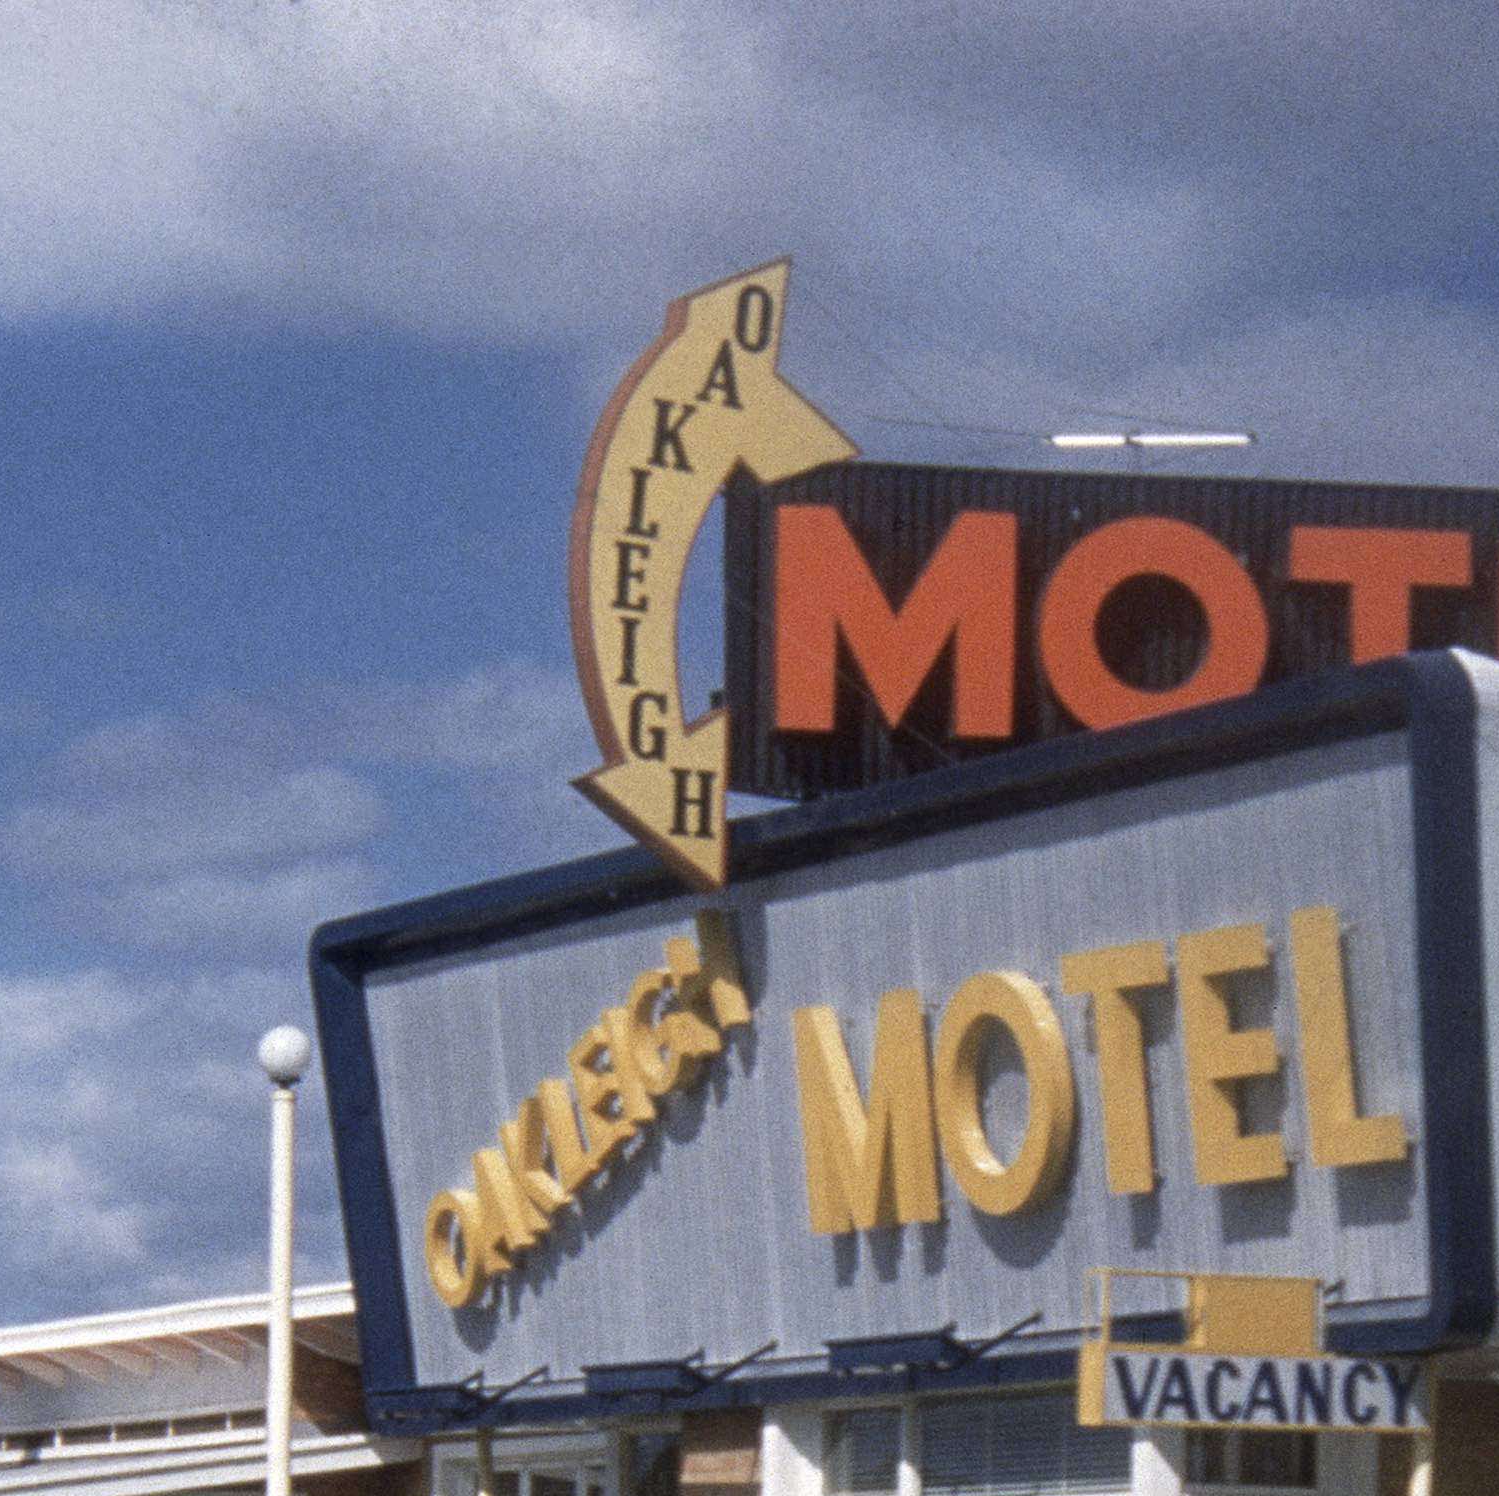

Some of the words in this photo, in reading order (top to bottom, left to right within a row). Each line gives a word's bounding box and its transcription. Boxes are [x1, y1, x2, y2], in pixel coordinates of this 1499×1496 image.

[611, 283, 775, 840] OAKLEIGH
[792, 906, 1408, 1236] MOTEL
[1111, 1355, 1420, 1425] VACANCY
